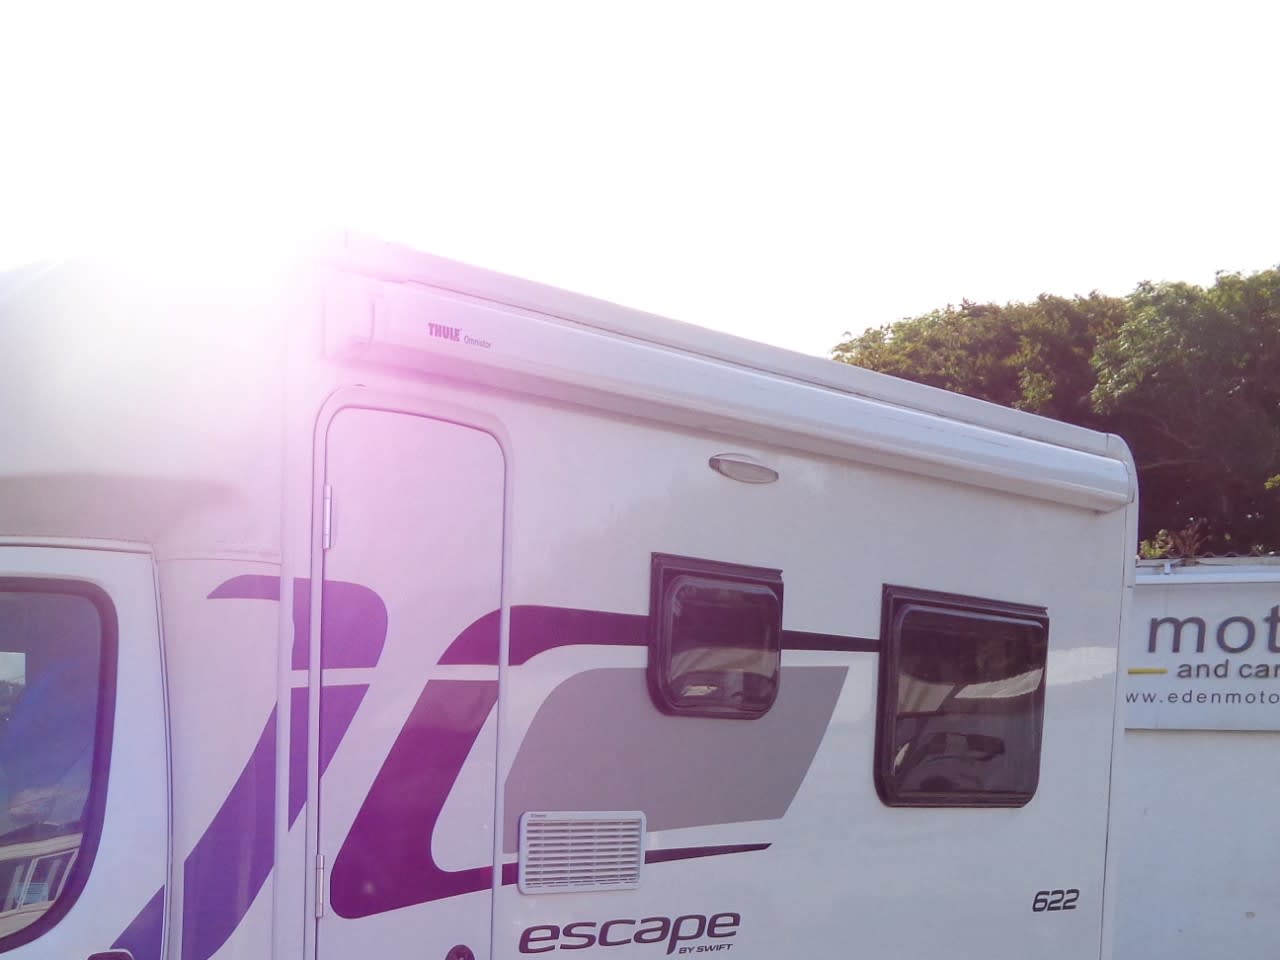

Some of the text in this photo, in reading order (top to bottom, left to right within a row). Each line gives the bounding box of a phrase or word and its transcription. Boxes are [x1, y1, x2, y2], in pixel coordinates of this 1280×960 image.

[427, 322, 462, 342] THULE
[1177, 658, 1229, 679] and
[1032, 888, 1080, 912] 622
[518, 912, 741, 955] escape
[678, 943, 734, 955] BY SWIFT
